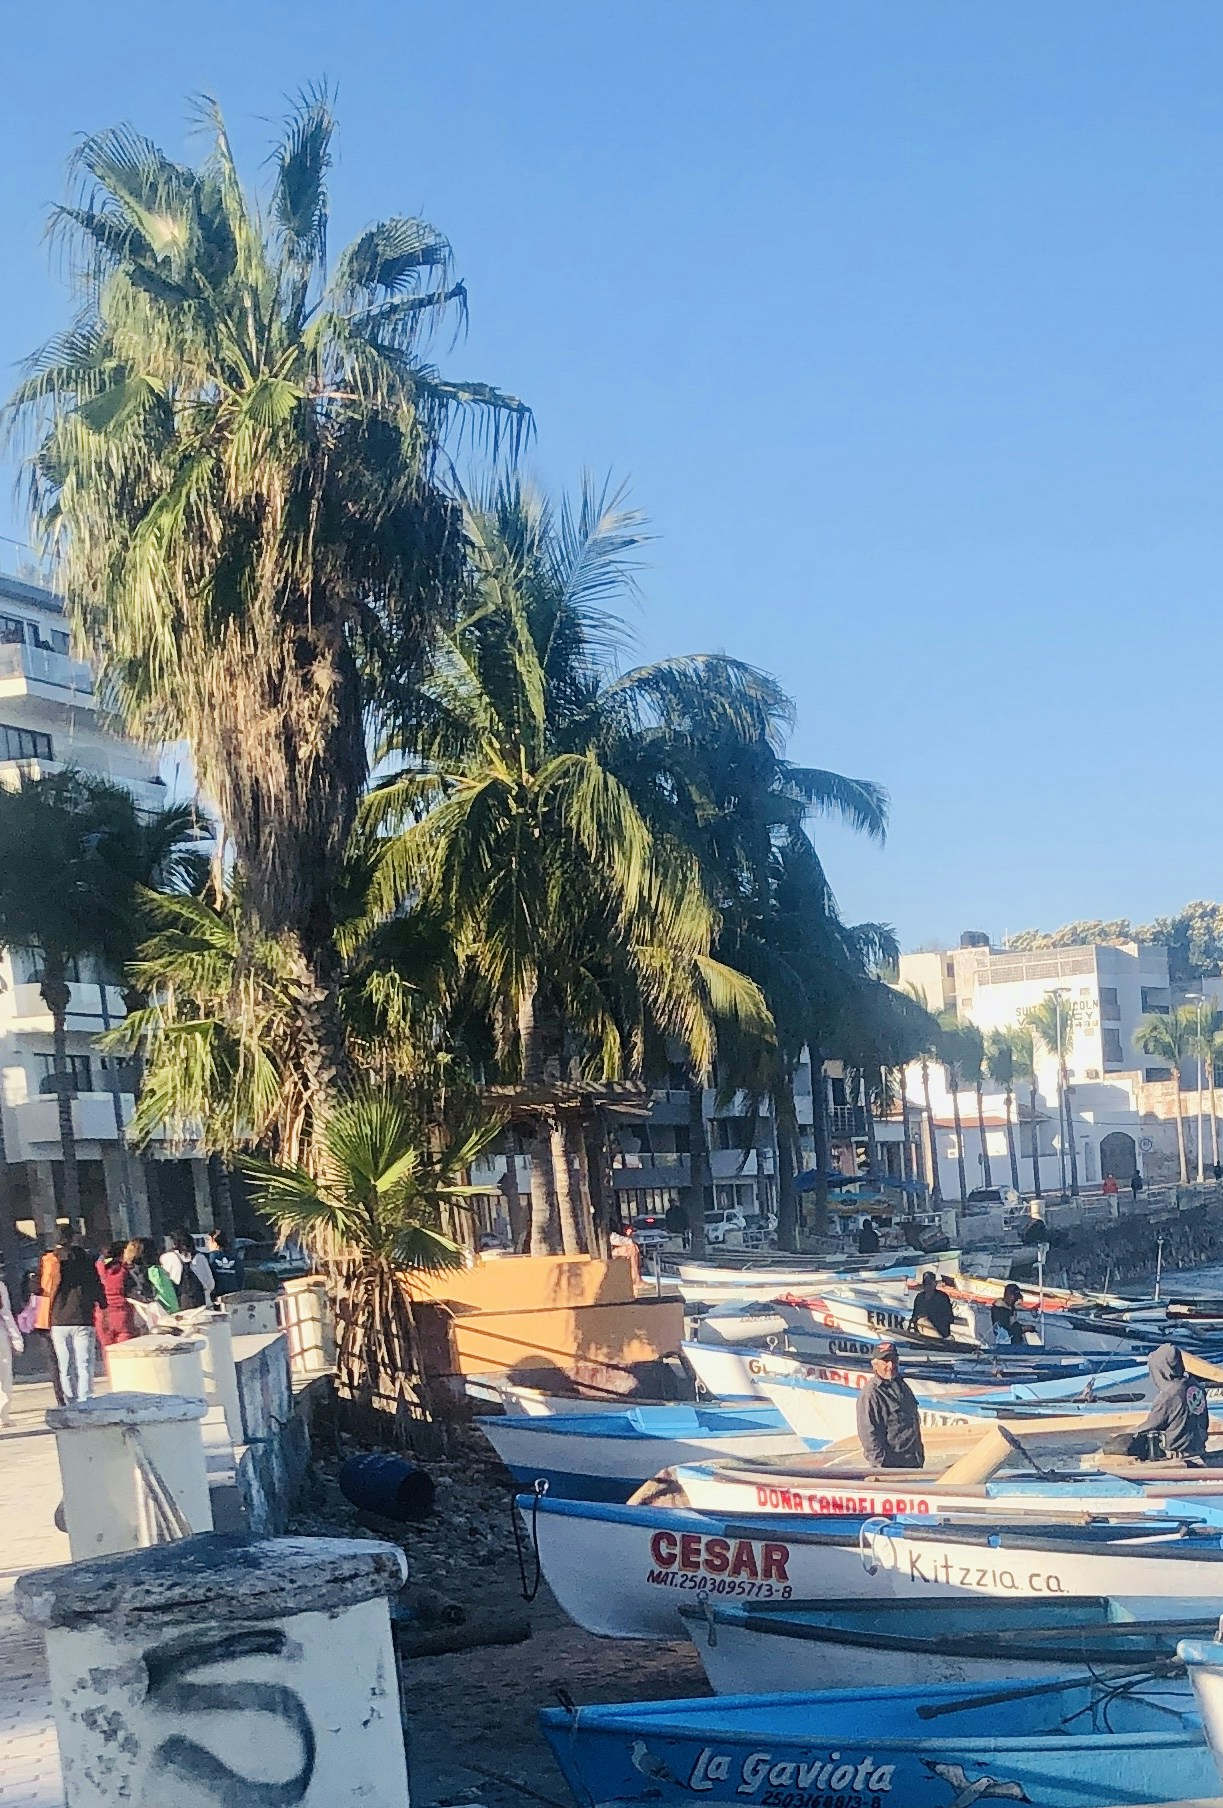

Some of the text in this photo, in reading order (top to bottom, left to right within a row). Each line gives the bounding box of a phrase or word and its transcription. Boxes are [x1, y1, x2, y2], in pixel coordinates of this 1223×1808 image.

[650, 1531, 789, 1583] CESAR
[689, 1747, 897, 1794] La Gaviota
